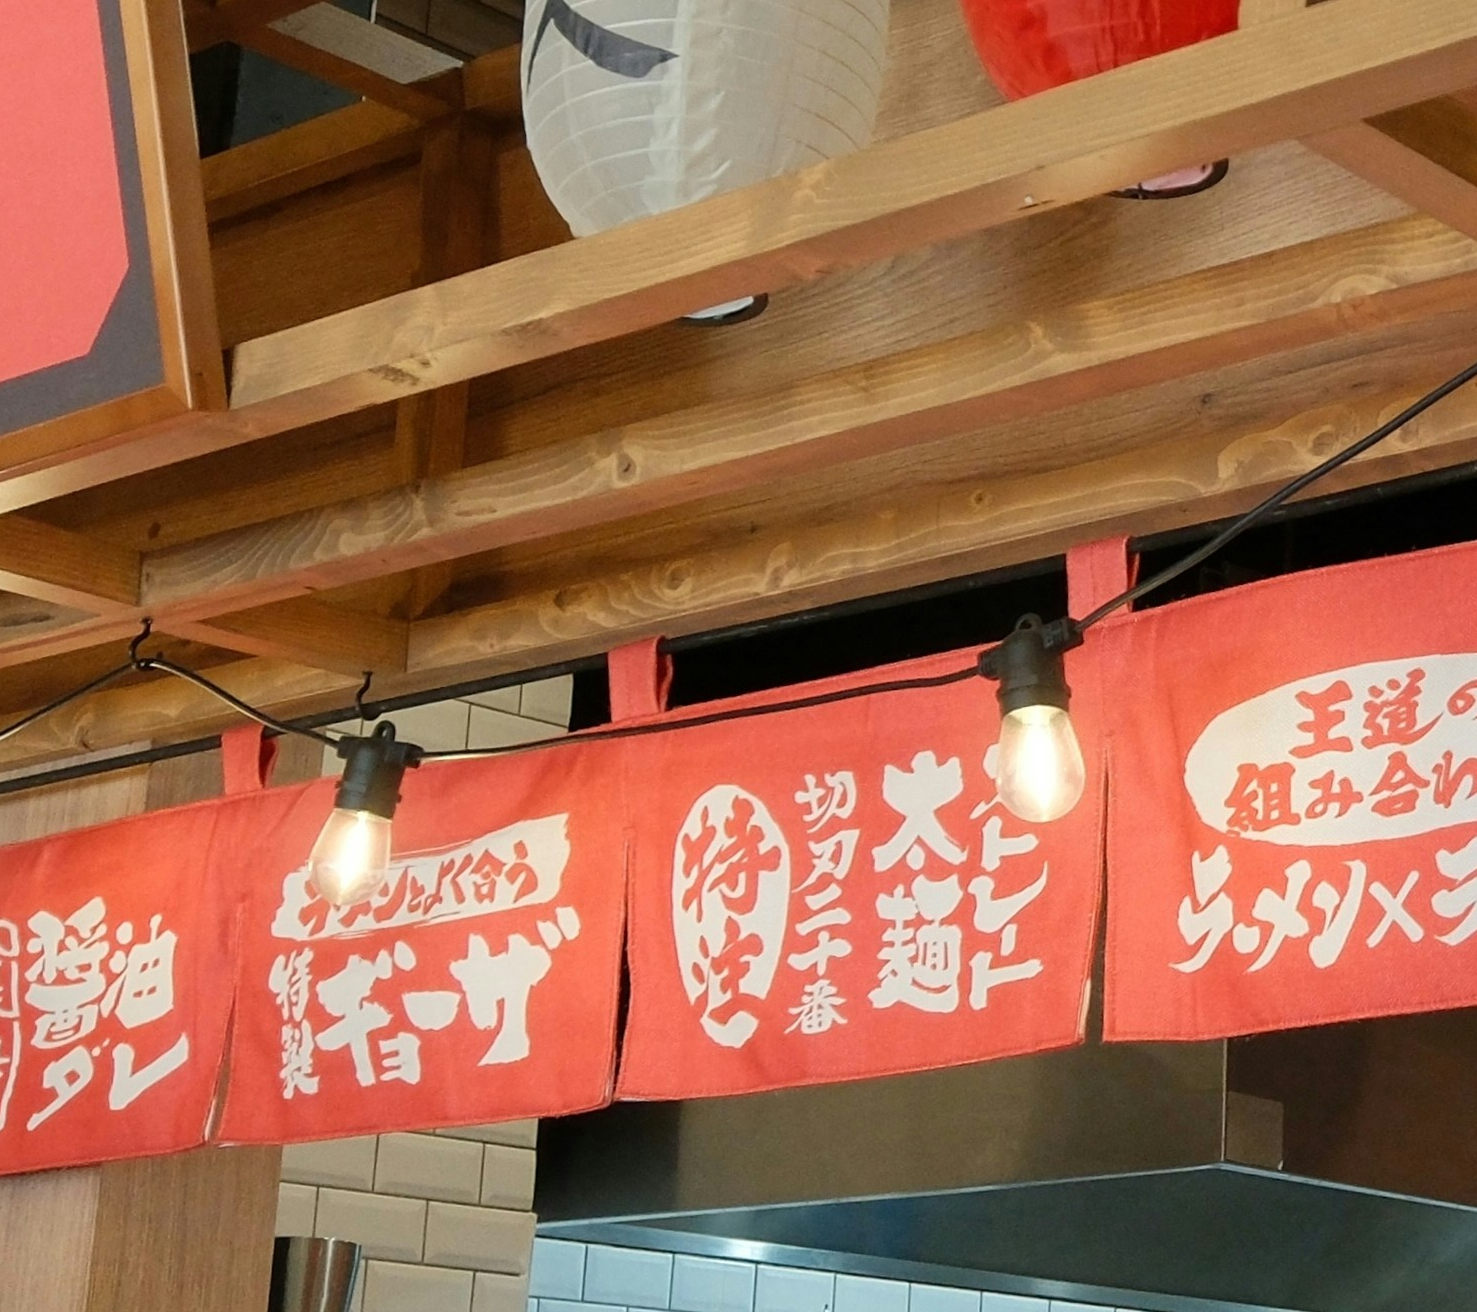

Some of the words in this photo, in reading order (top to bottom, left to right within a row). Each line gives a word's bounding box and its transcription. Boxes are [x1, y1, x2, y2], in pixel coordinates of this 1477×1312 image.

[314, 905, 581, 1088] ギョーザ
[783, 769, 862, 1036] 切刃二十番
[867, 750, 969, 1014] 太麺
[968, 744, 1053, 1012] トレート
[268, 947, 320, 1100] 特製
